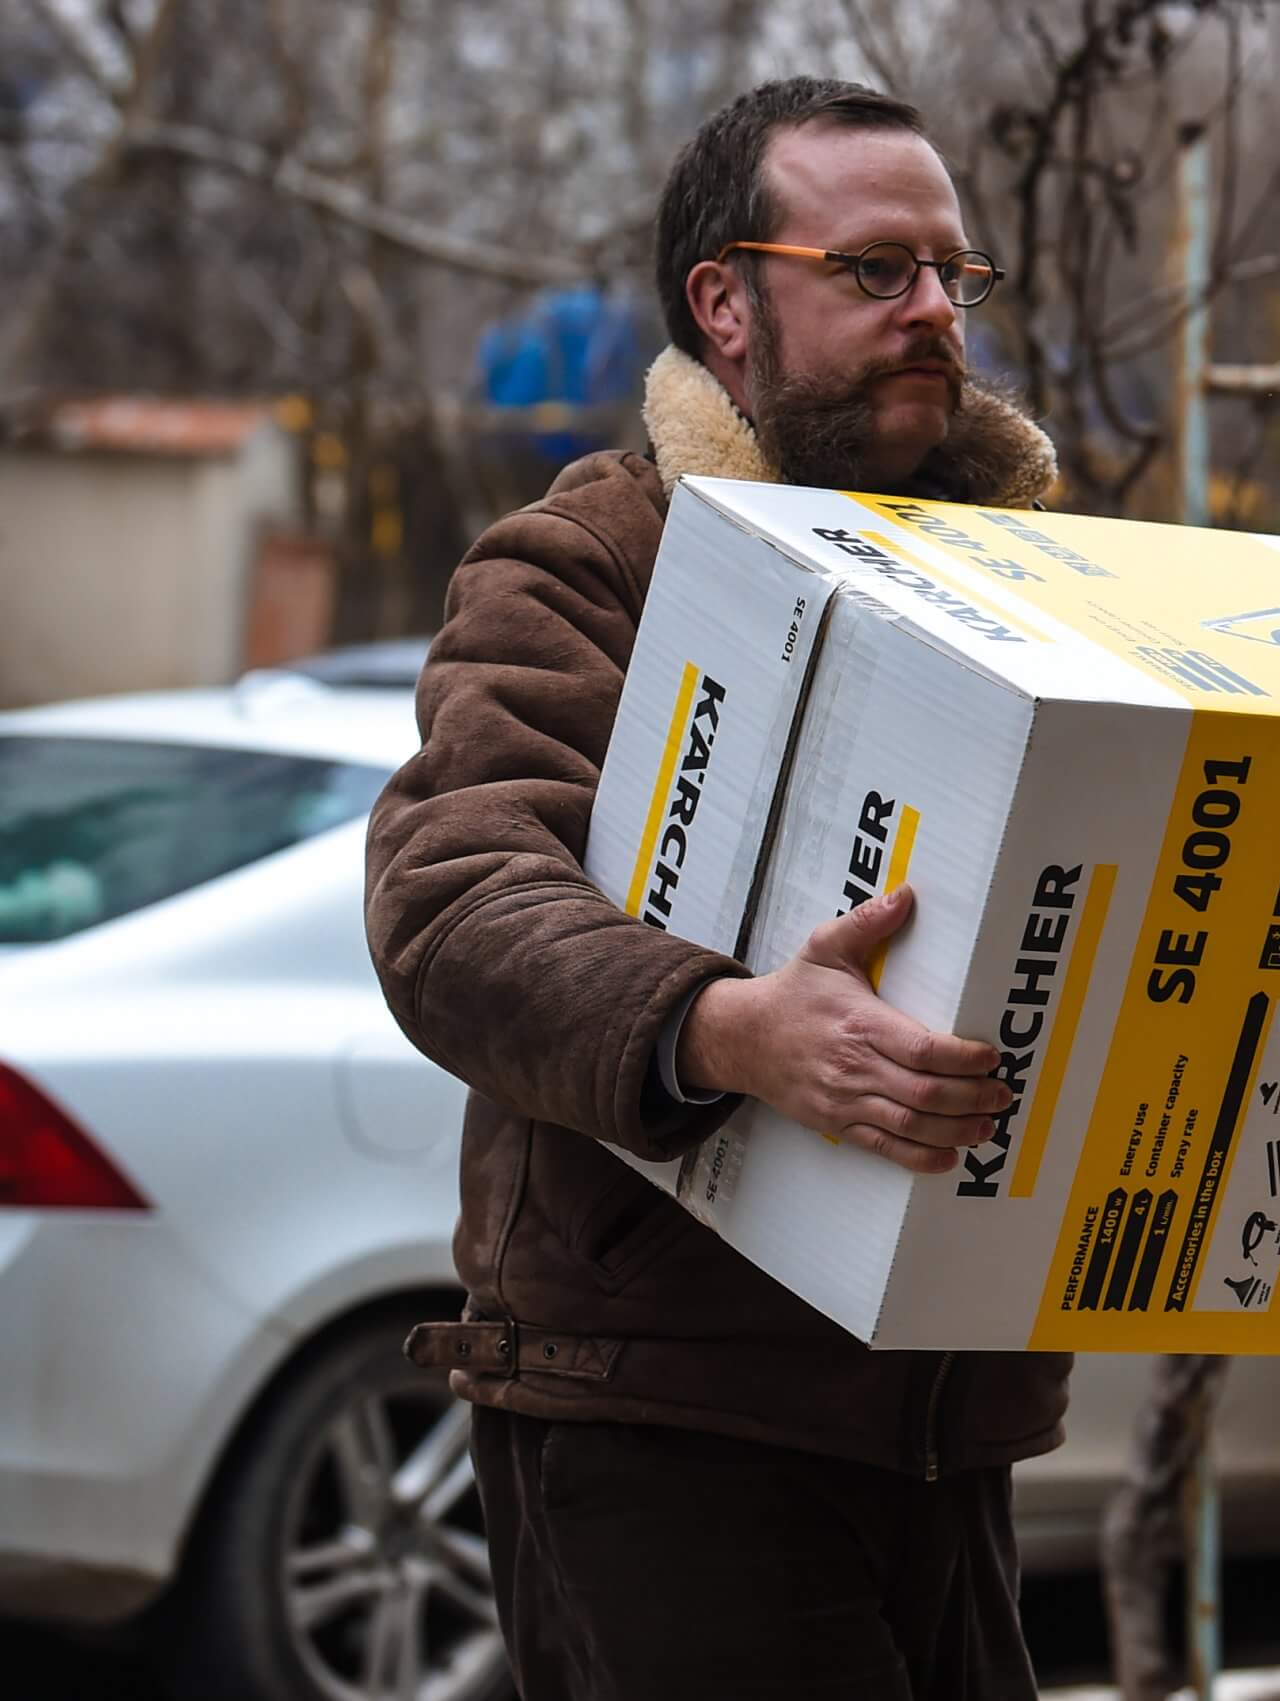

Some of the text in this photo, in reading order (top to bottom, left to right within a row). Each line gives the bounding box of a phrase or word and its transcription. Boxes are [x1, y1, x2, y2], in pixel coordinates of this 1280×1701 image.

[812, 527, 1028, 643] KÄRCHER
[875, 502, 1047, 583] SE 4001
[781, 596, 807, 664] SE 4001
[643, 674, 727, 931] KÄRCH
[1147, 756, 1252, 1004] SE 4001
[1120, 1104, 1148, 1176] Energy use
[1146, 1055, 1188, 1176] Container capacity
[1170, 1109, 1198, 1177] Spray rate
[1061, 1207, 1098, 1310] PERFORMANCE
[1101, 1210, 1118, 1243] 1400
[1172, 1151, 1223, 1300] Accessories in the box
